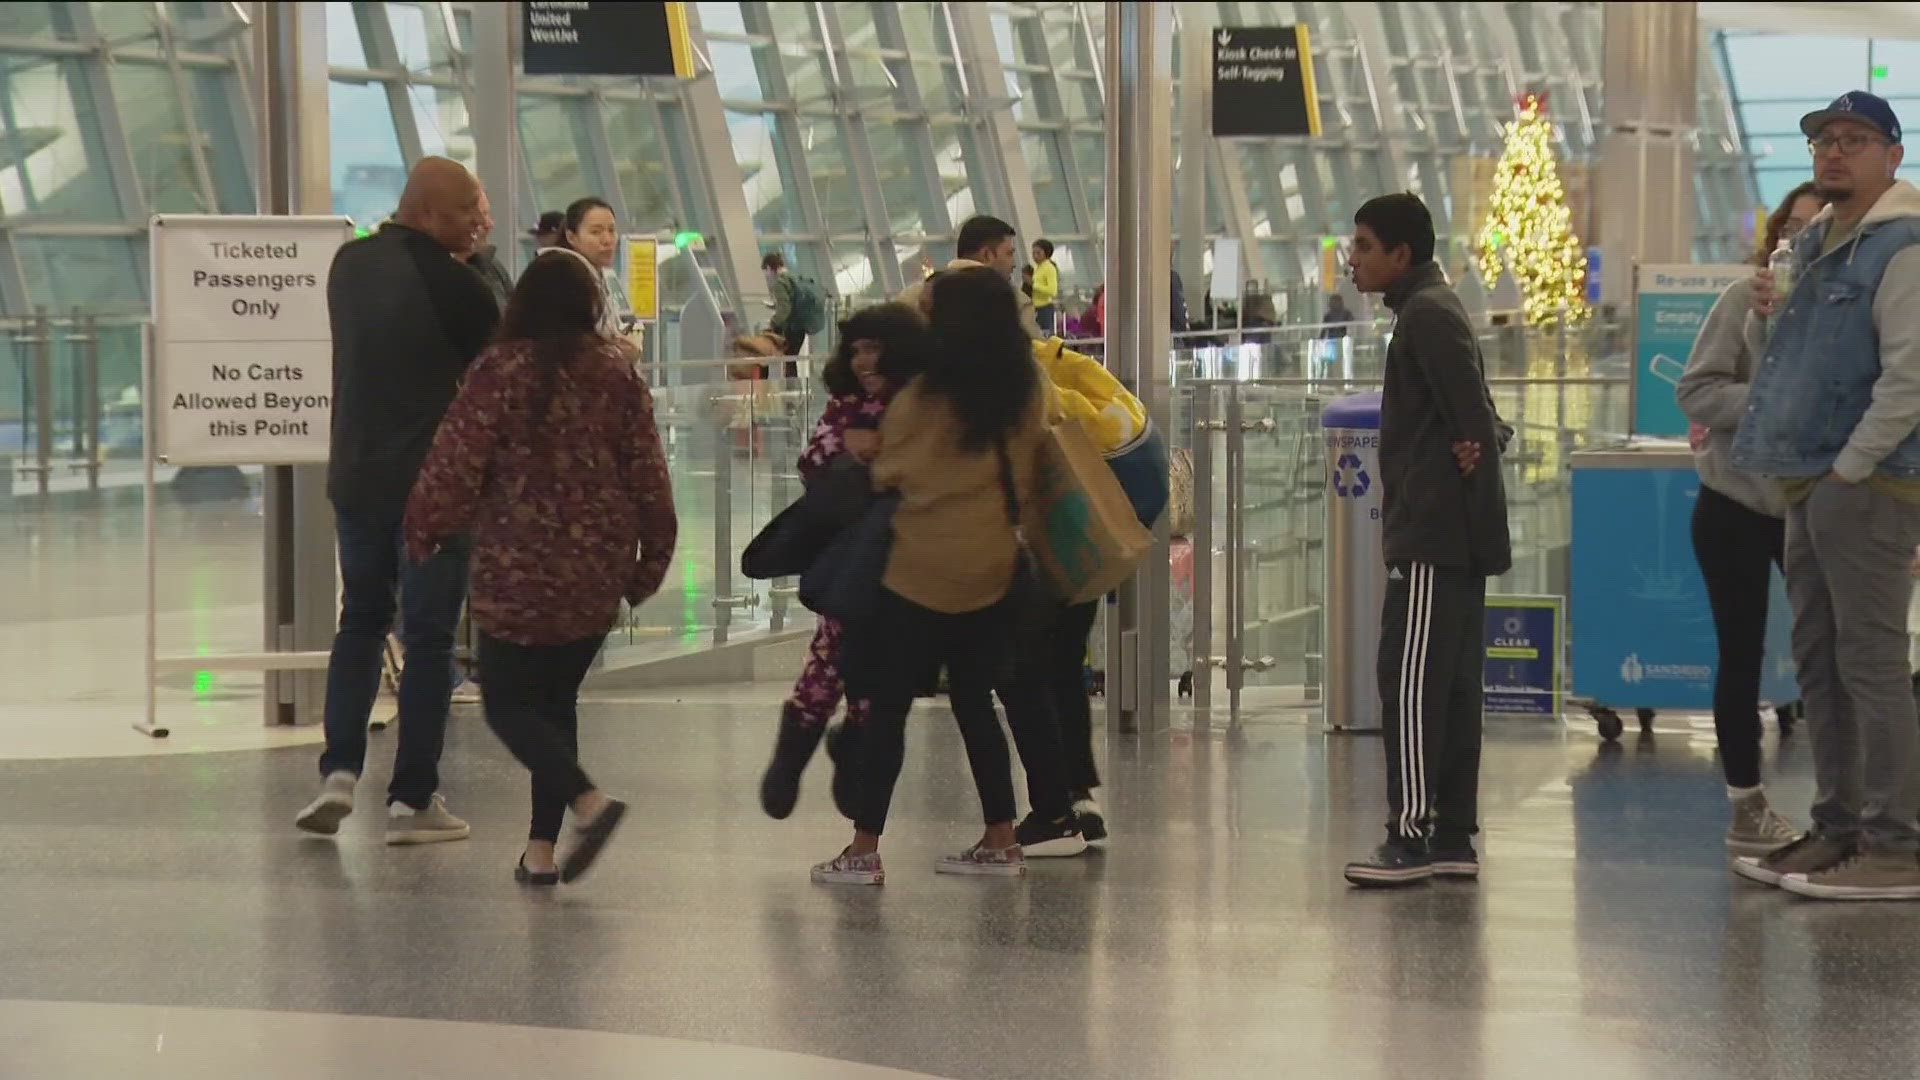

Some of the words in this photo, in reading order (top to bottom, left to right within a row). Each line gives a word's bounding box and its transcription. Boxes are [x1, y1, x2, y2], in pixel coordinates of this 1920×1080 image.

[530, 11, 571, 26] United
[530, 28, 579, 43] WestJet
[1217, 47, 1247, 60] Kiosk
[1217, 66, 1285, 82] Self-Tagging
[210, 242, 298, 258] Ticketed
[193, 271, 316, 291] Passengers
[1656, 273, 1706, 287] Re-use
[231, 299, 280, 319] Only
[1655, 310, 1703, 327] Empty
[212, 364, 241, 381] No
[247, 364, 303, 381] Carts
[172, 393, 257, 409] Allowed
[264, 393, 329, 413] Beyon
[209, 420, 247, 436] this
[254, 419, 308, 436] Point
[1494, 637, 1531, 647] CLEAR
